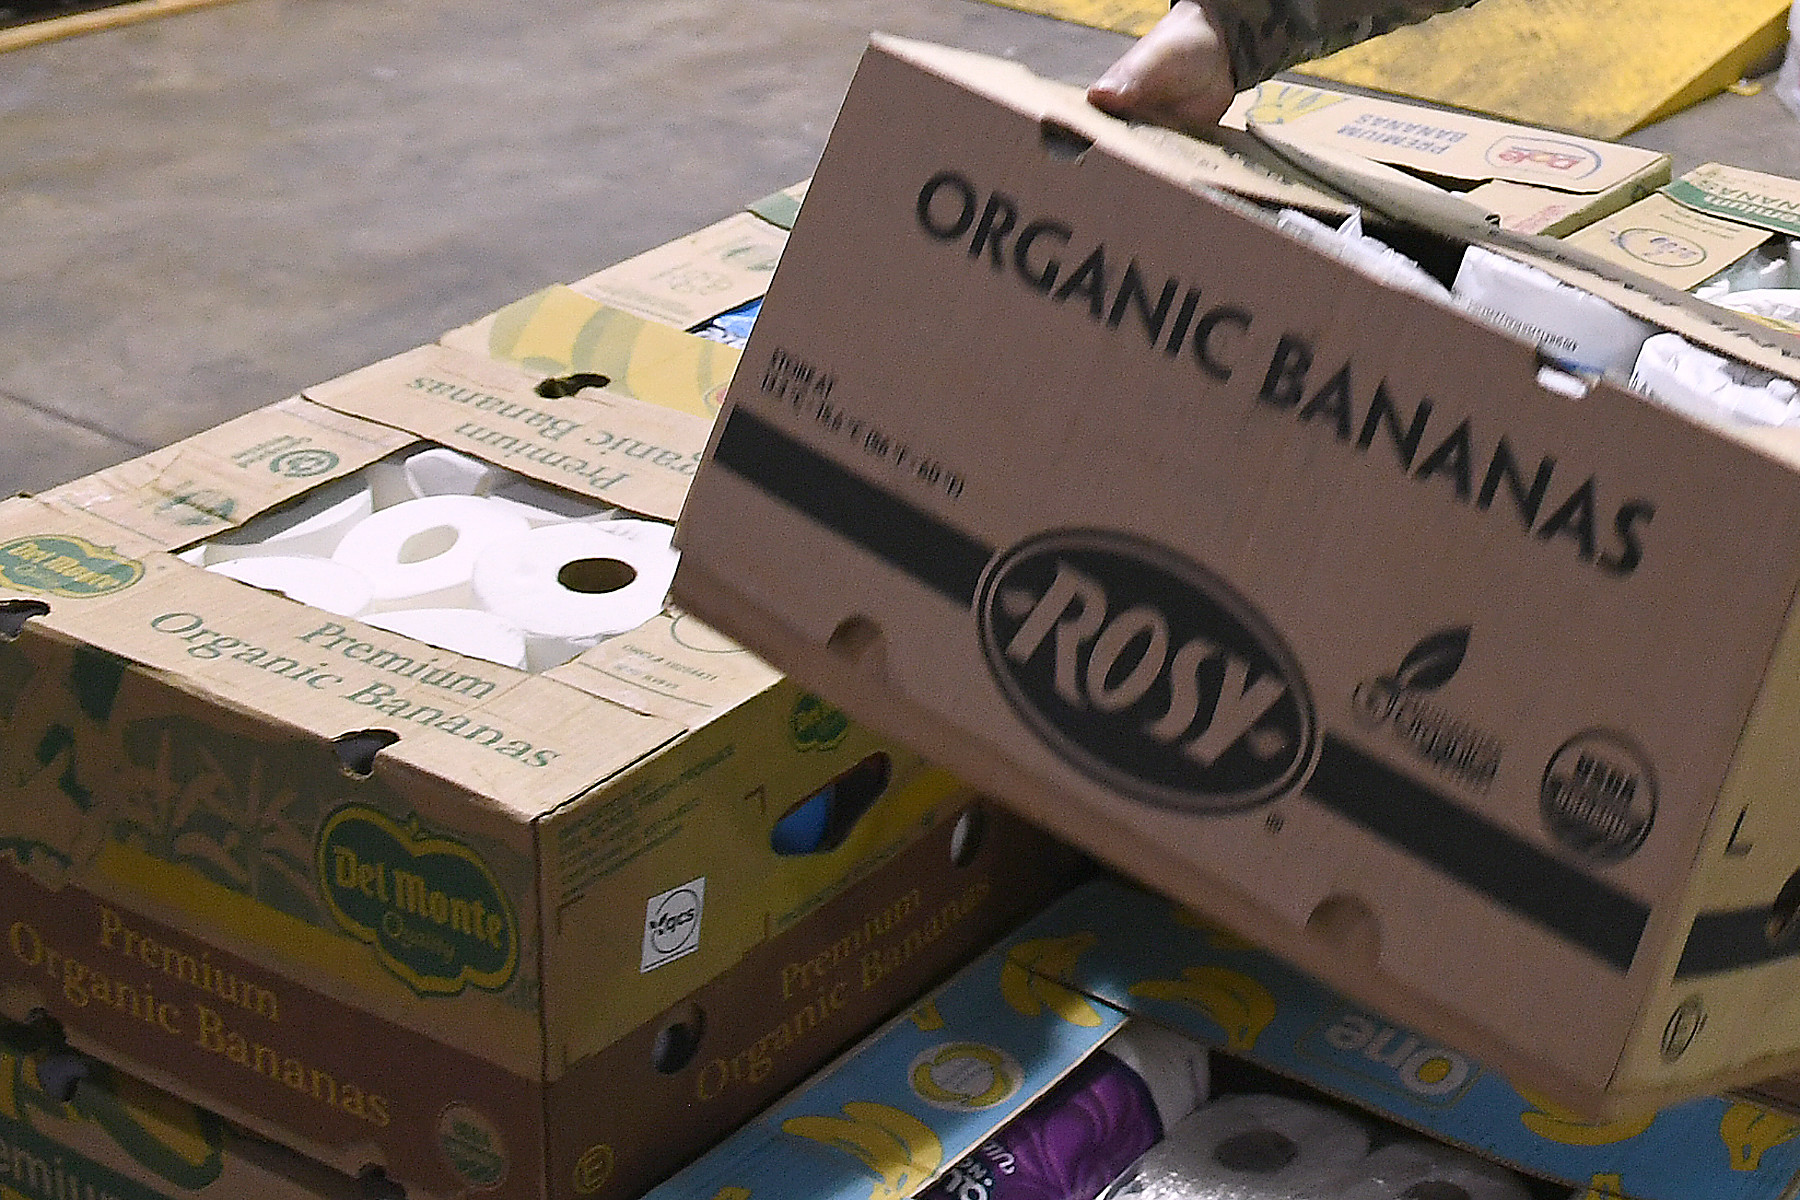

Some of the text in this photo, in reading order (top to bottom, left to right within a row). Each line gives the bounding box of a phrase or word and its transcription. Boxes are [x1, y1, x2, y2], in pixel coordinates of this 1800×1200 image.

[406, 375, 702, 478] ganic Bananas
[916, 171, 1656, 578] ORGANIC BANANAS
[454, 421, 631, 491] Premium
[149, 609, 565, 772] Organic Bananas
[299, 621, 499, 702] Premium
[1005, 557, 1288, 768] ROSY
[331, 844, 503, 948] Del Monte
[780, 887, 923, 1000] Premium
[100, 906, 282, 1024] Premium
[9, 920, 392, 1129] Organic Bananas
[699, 977, 849, 1103] Organic
[1321, 1010, 1470, 1095] One
